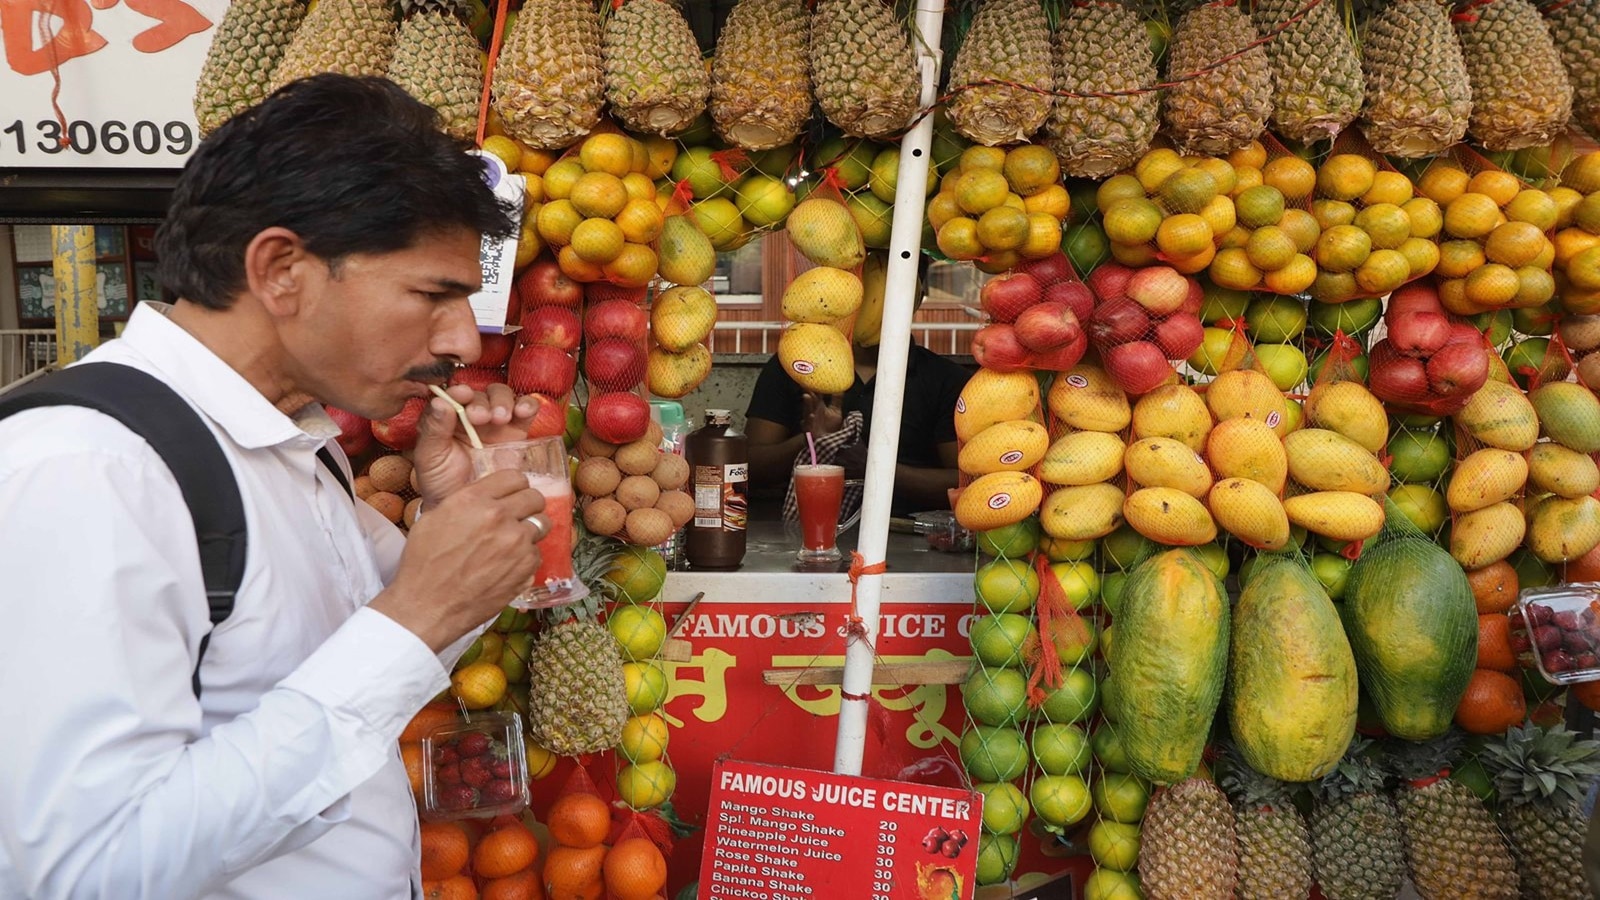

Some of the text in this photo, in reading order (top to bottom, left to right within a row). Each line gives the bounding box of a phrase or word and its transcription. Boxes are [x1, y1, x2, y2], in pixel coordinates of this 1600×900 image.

[0, 119, 193, 155] 130609
[671, 613, 826, 638] FAMOUS
[837, 613, 946, 638] ICE
[720, 771, 970, 820] FAMOUS JUICE CENTER
[719, 812, 896, 843] Spl. Mango Shake 30
[720, 800, 898, 831] Mango Shake 20
[717, 836, 893, 868] Watermelon Juice 30
[718, 824, 895, 856] Pineapple Juice 30
[714, 860, 891, 892] Papita Shake 30
[715, 848, 892, 880] Rose Shake 30
[711, 884, 768, 900] Chickoo
[712, 872, 764, 887] Banana
[768, 880, 813, 894] Shake
